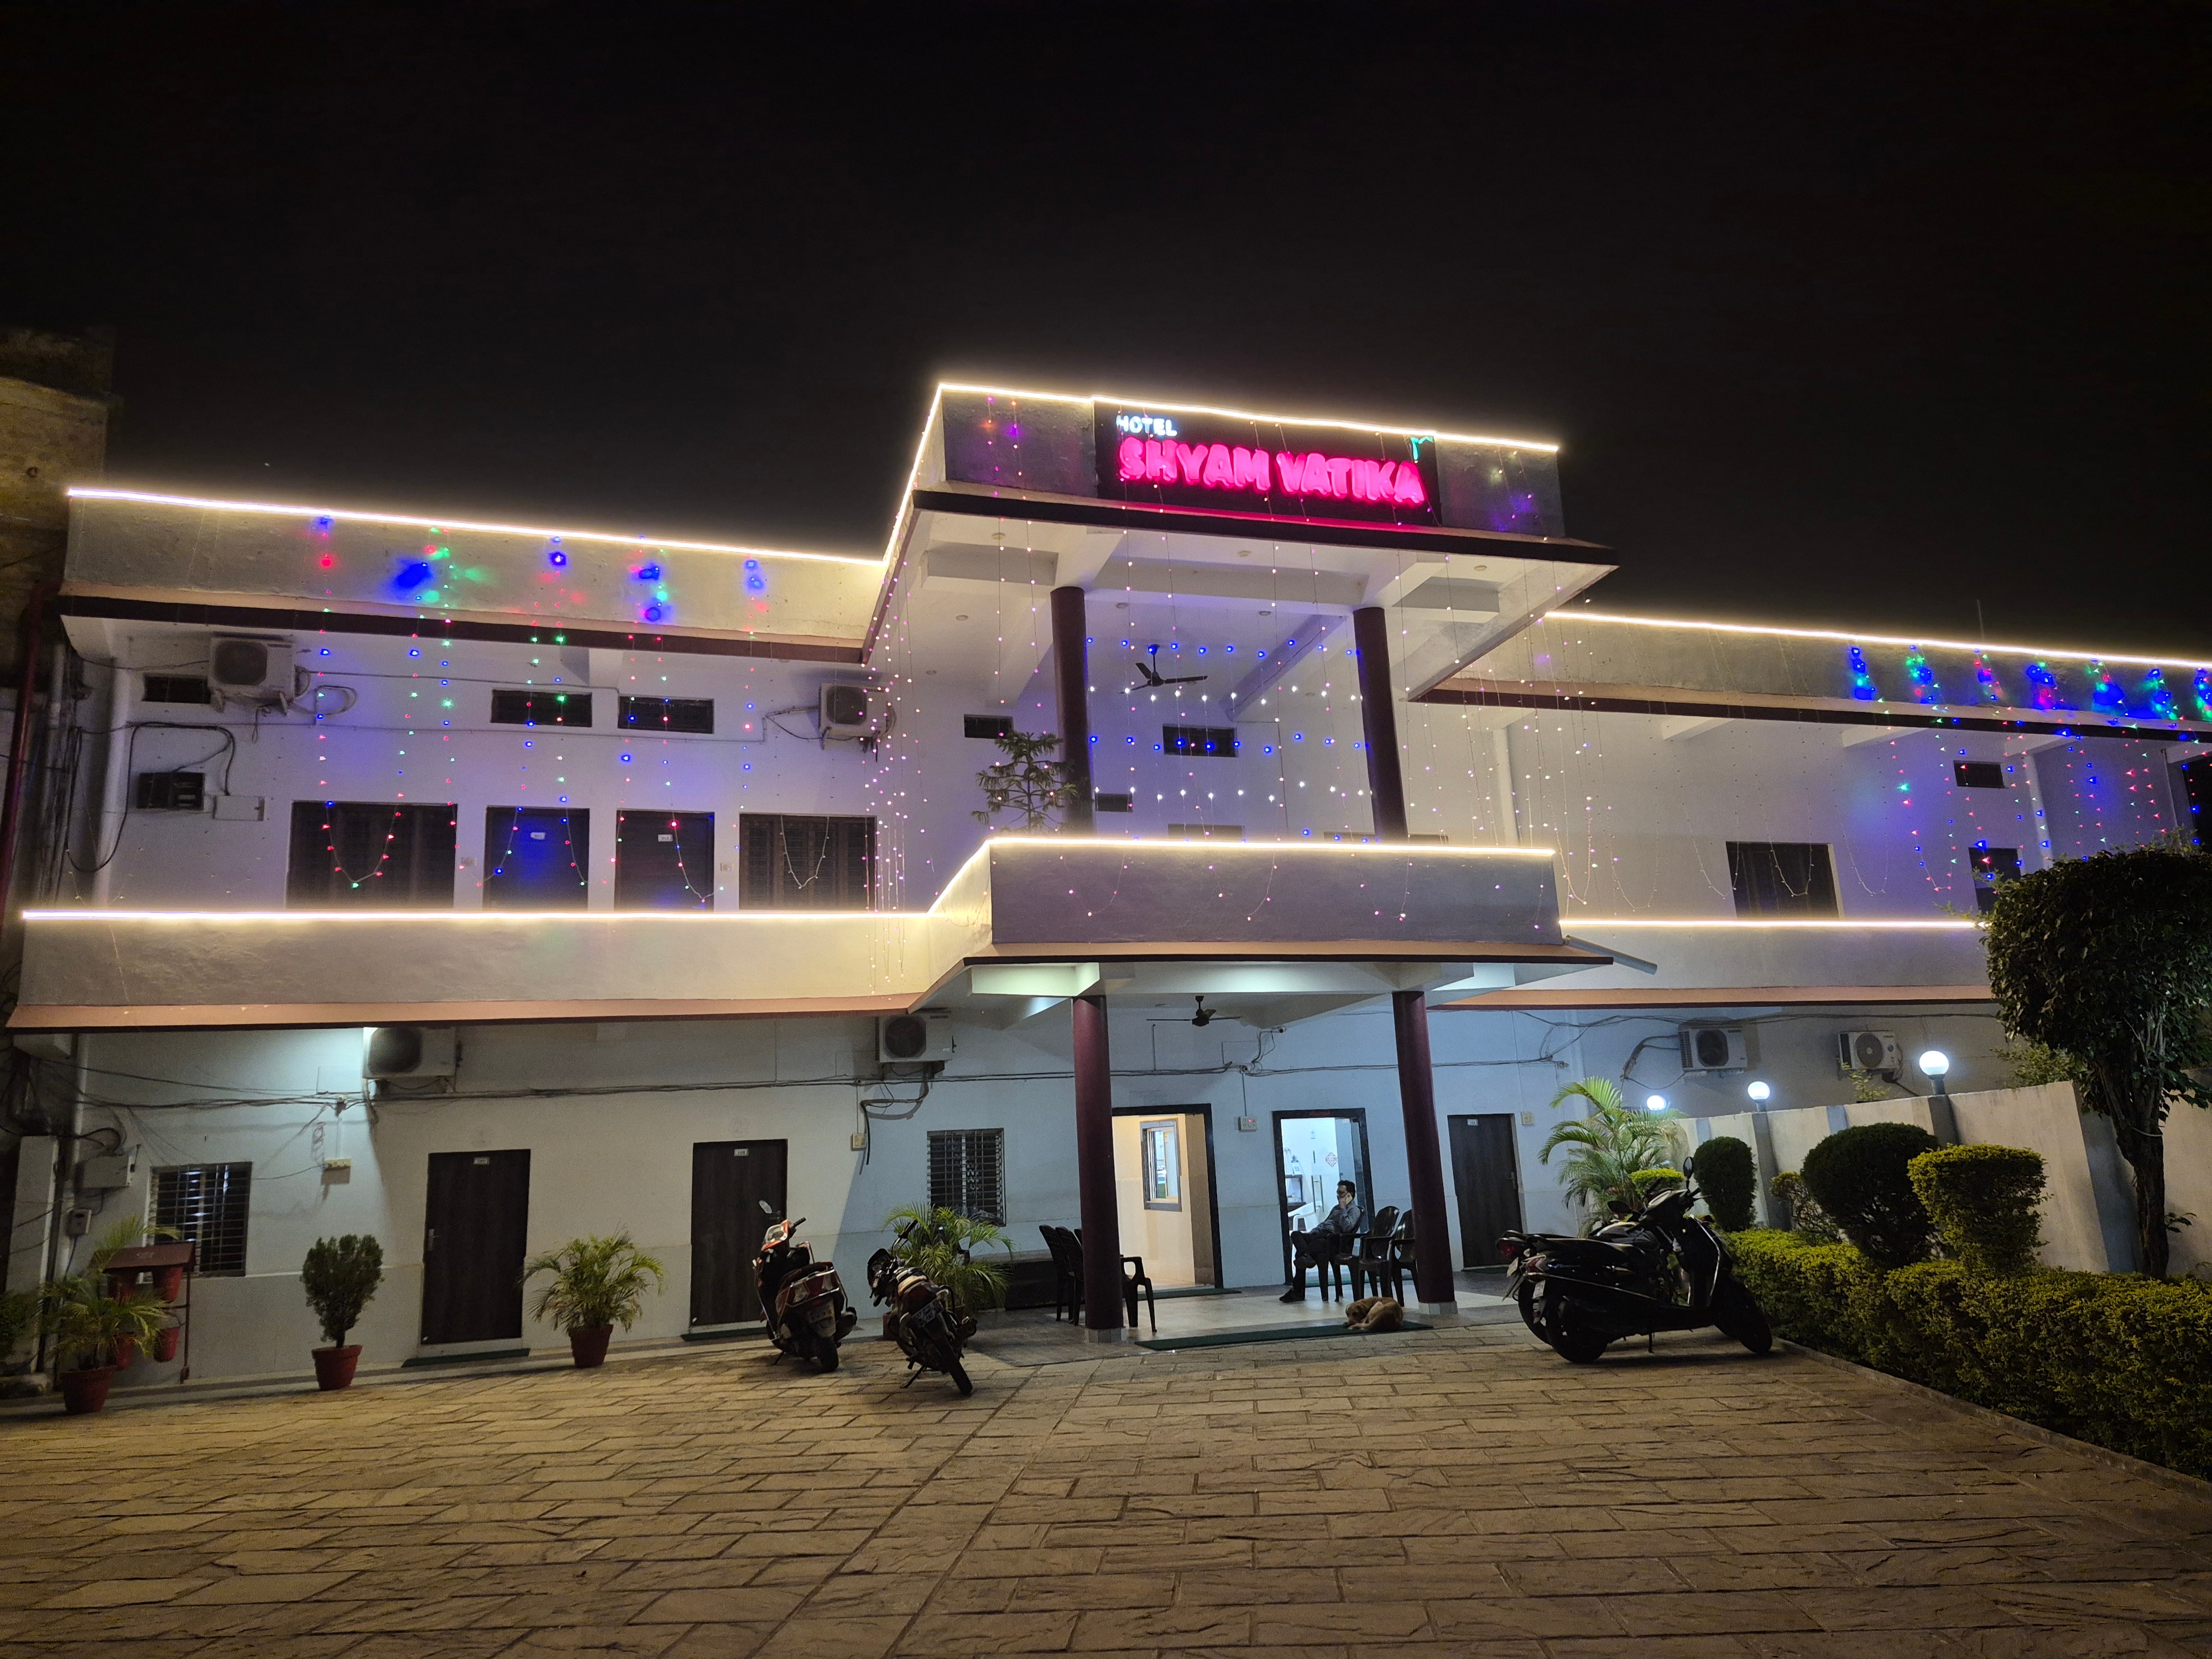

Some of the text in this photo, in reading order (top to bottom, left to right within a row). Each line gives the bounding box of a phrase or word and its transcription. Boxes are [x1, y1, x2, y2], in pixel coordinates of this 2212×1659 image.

[1116, 415, 1177, 436] HOTEL
[1119, 435, 1425, 504] SHYAM VATIKA
